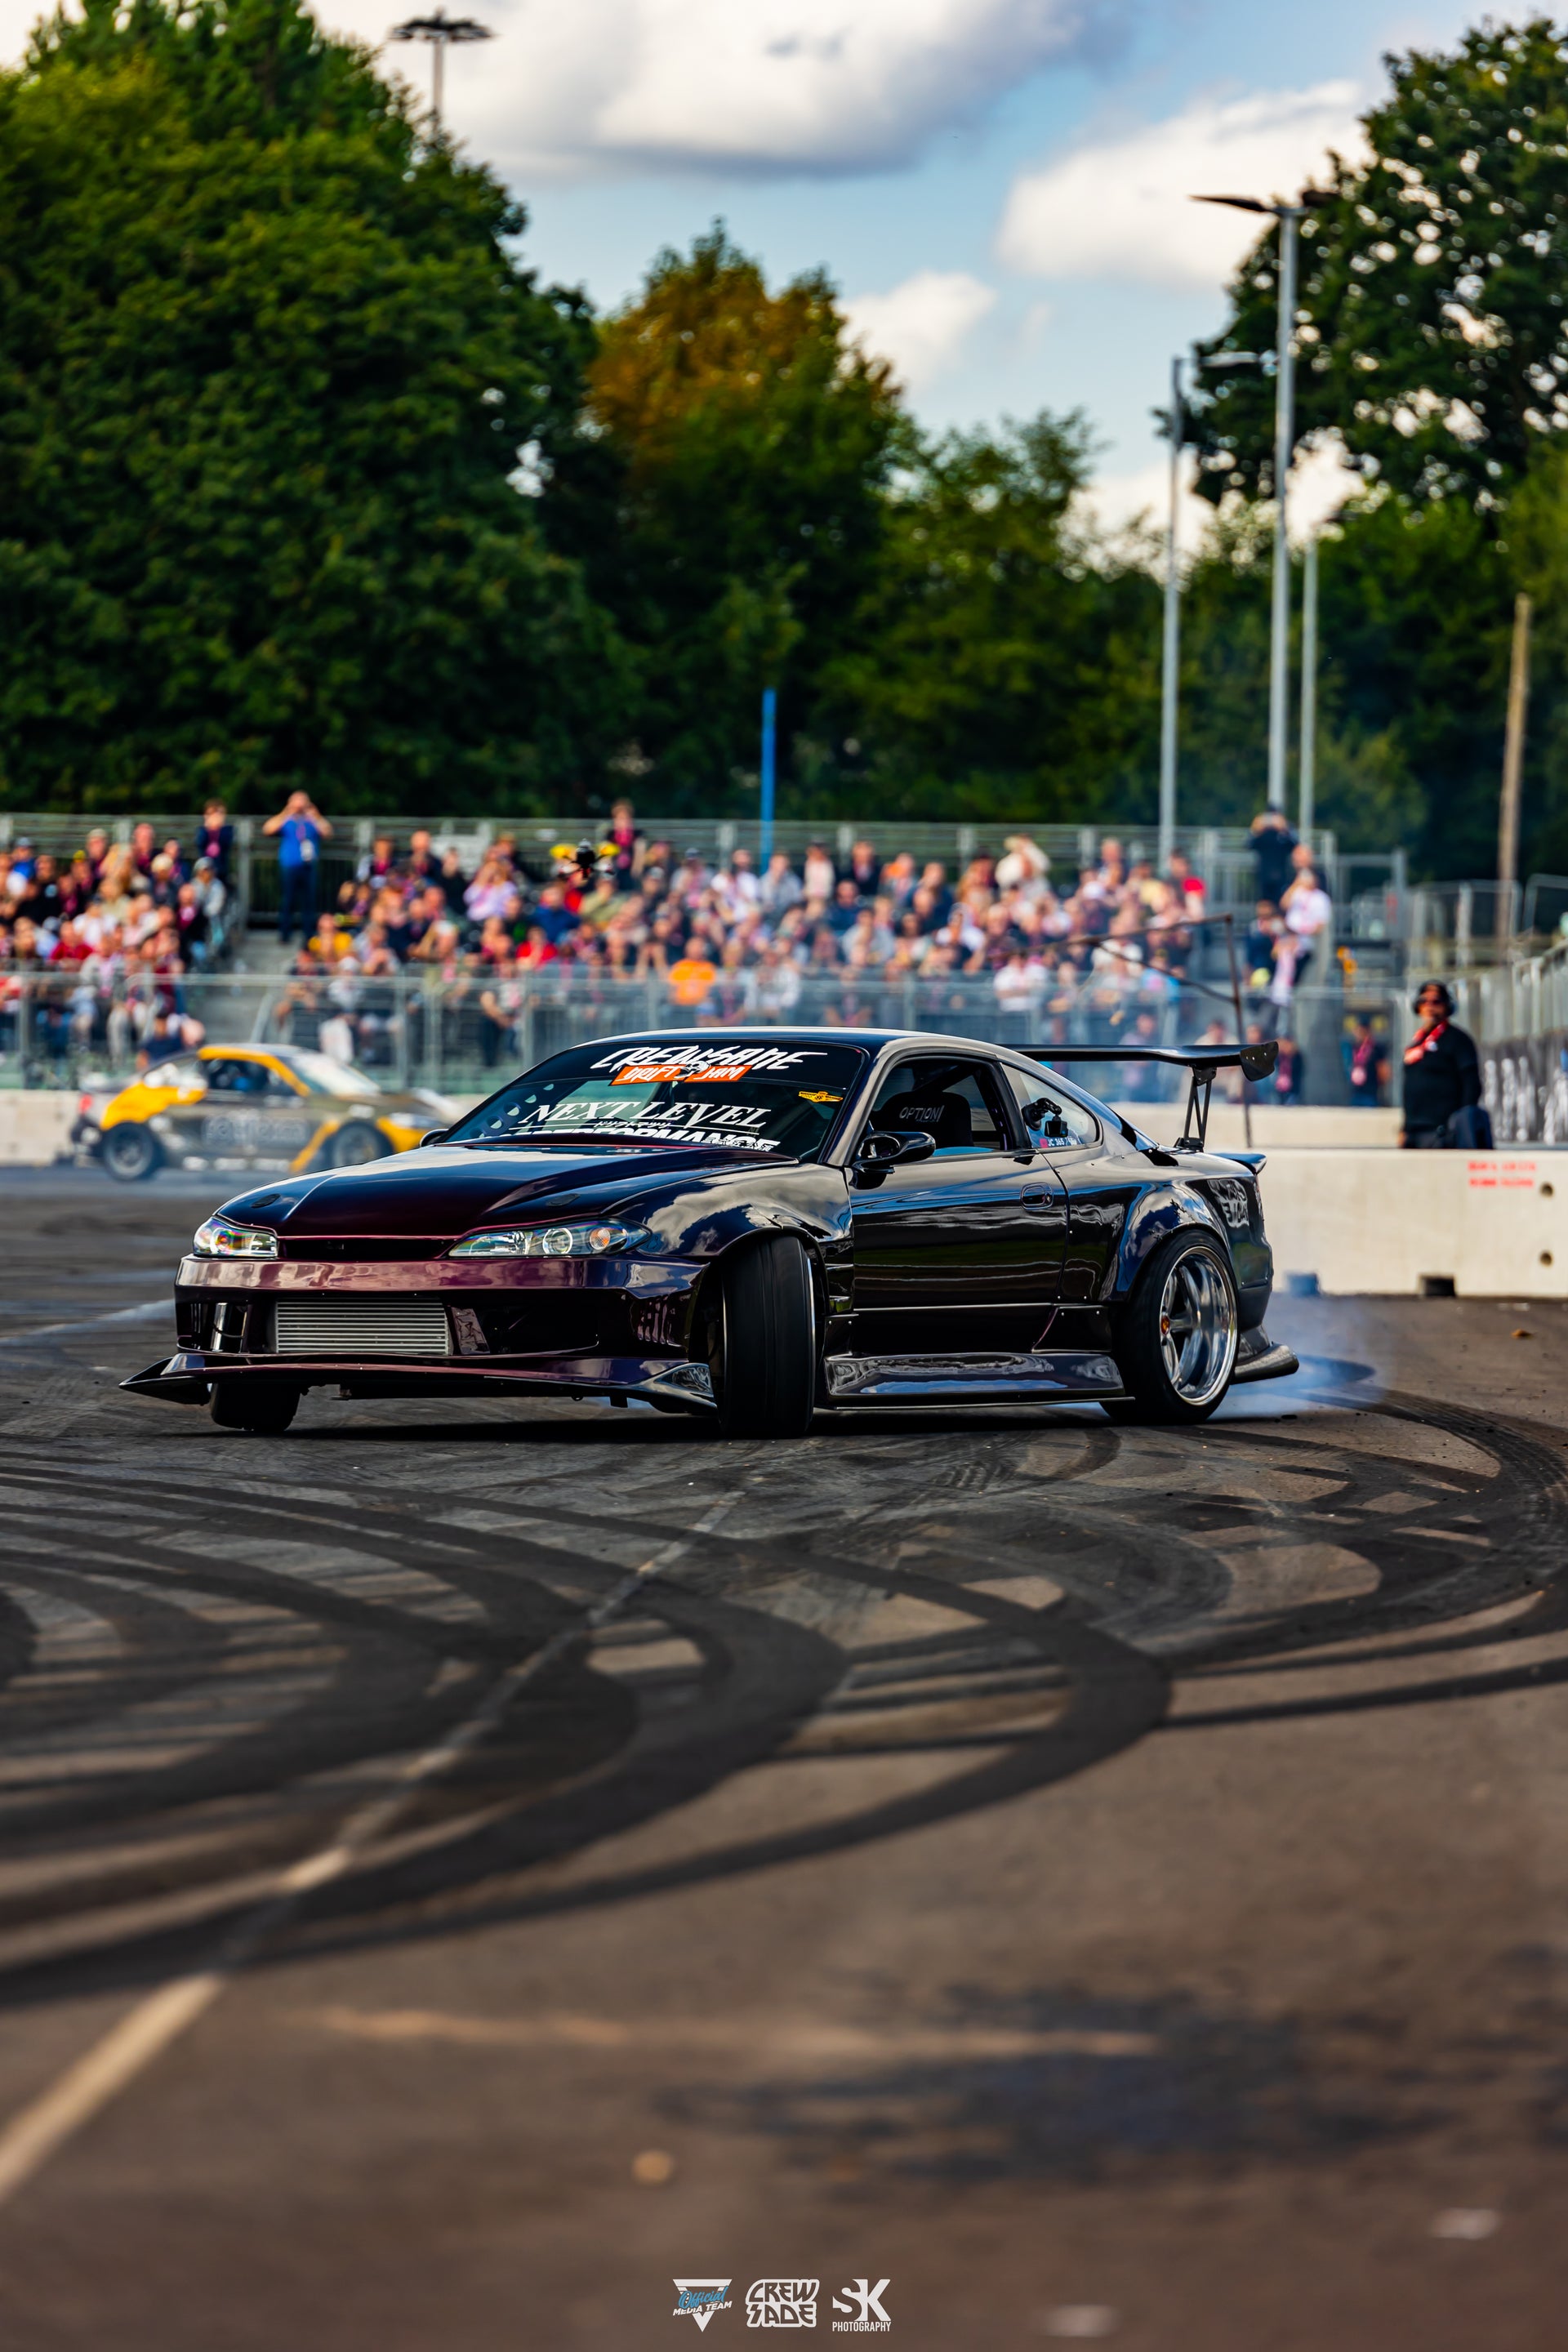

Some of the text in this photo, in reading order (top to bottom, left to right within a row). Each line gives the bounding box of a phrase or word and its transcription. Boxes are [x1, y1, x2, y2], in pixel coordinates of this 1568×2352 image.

[615, 1065, 745, 1082] DRIFT JAM
[518, 1102, 771, 1129] NEXT LEVEL
